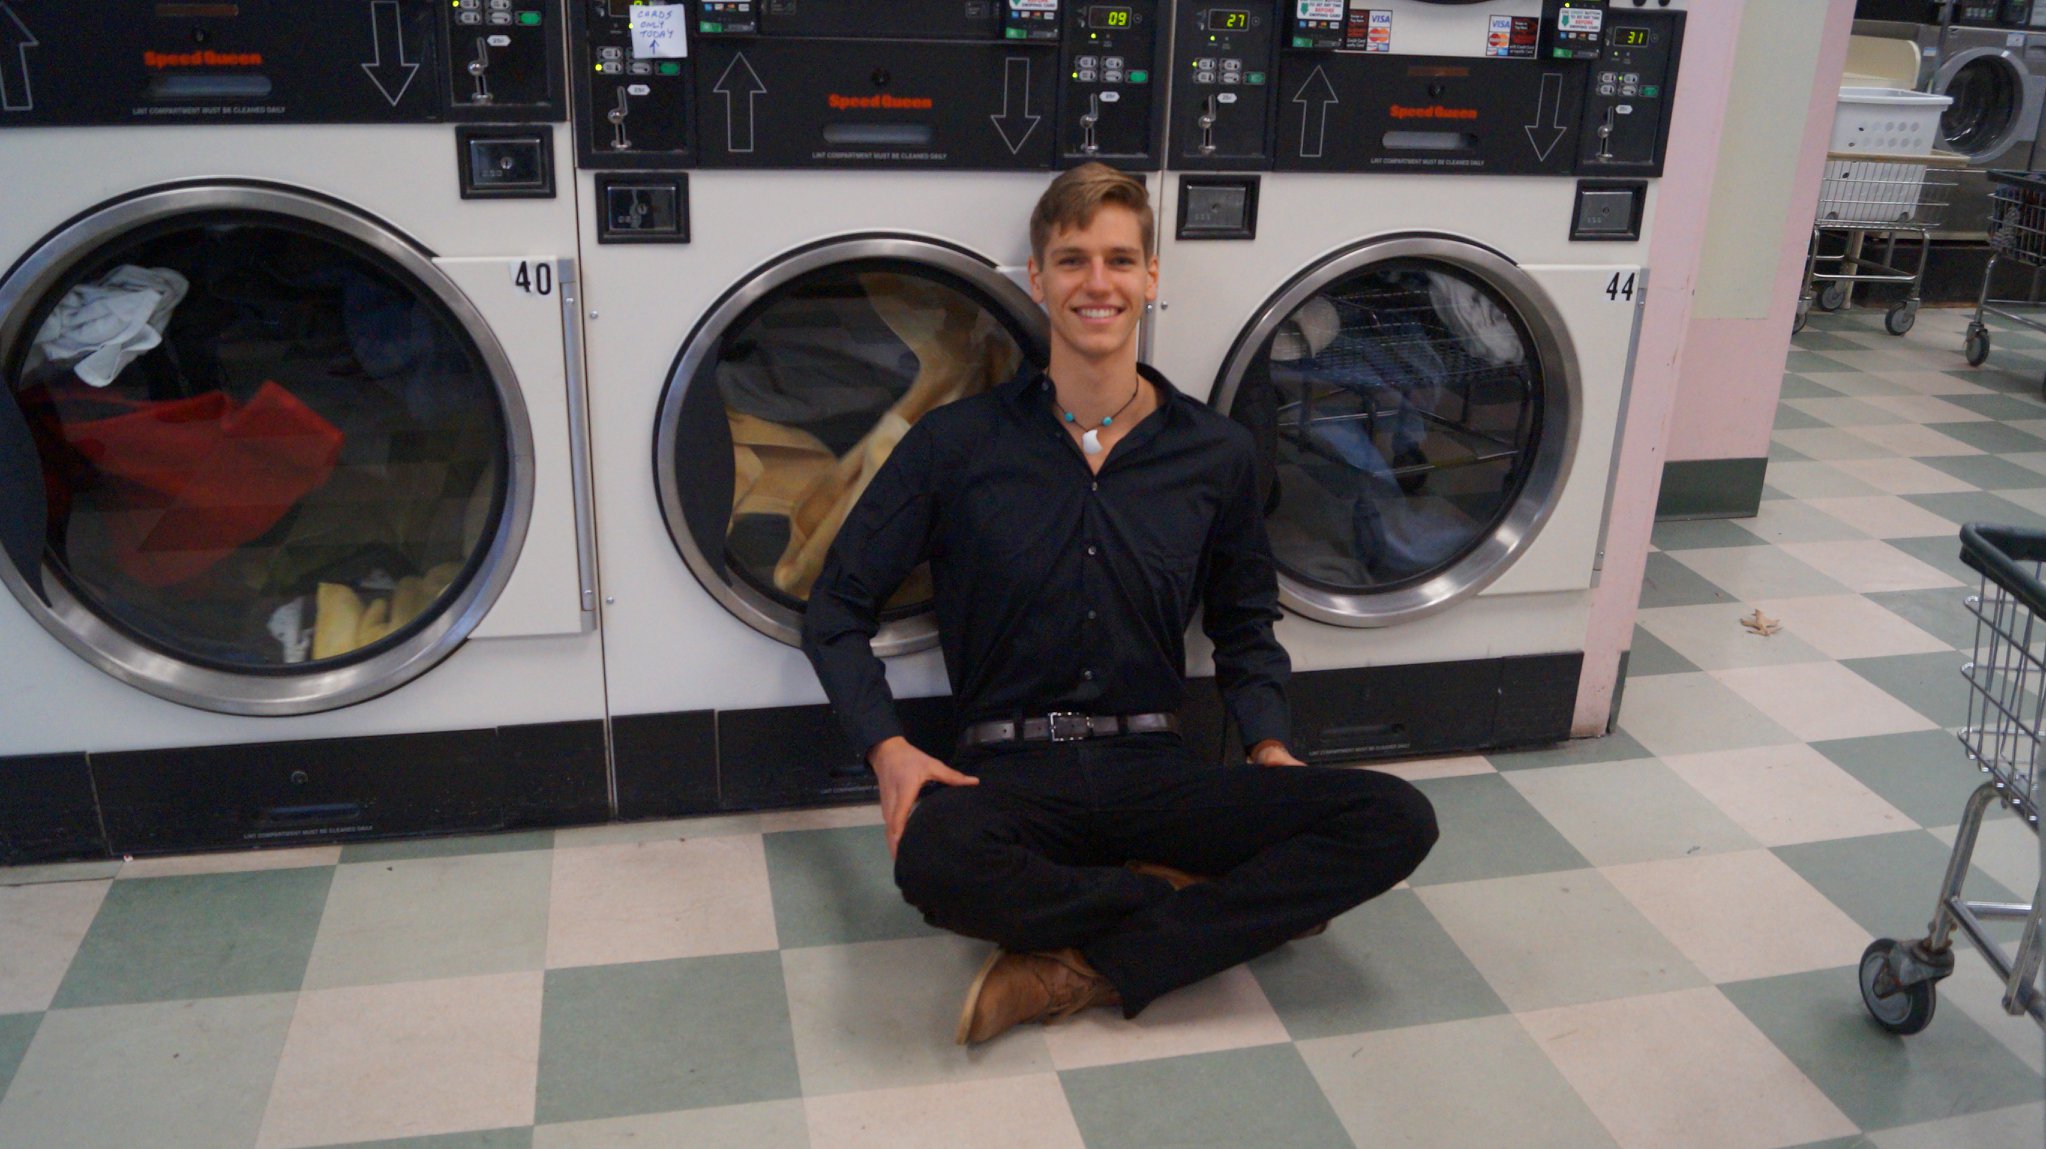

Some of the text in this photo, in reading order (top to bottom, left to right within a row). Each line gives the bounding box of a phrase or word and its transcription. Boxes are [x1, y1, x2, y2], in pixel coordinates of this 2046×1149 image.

[637, 10, 673, 19] CARDS
[1108, 11, 1127, 26] 09
[1372, 15, 1390, 23] VISA
[1226, 13, 1245, 27] 27
[1492, 20, 1510, 28] VISA
[640, 21, 665, 29] ONLY
[640, 30, 674, 39] TODAY
[1627, 31, 1644, 44] 31
[233, 106, 265, 114] CLEANED
[267, 106, 285, 114] DAILY
[515, 261, 551, 295] 40
[1606, 272, 1635, 301] 44
